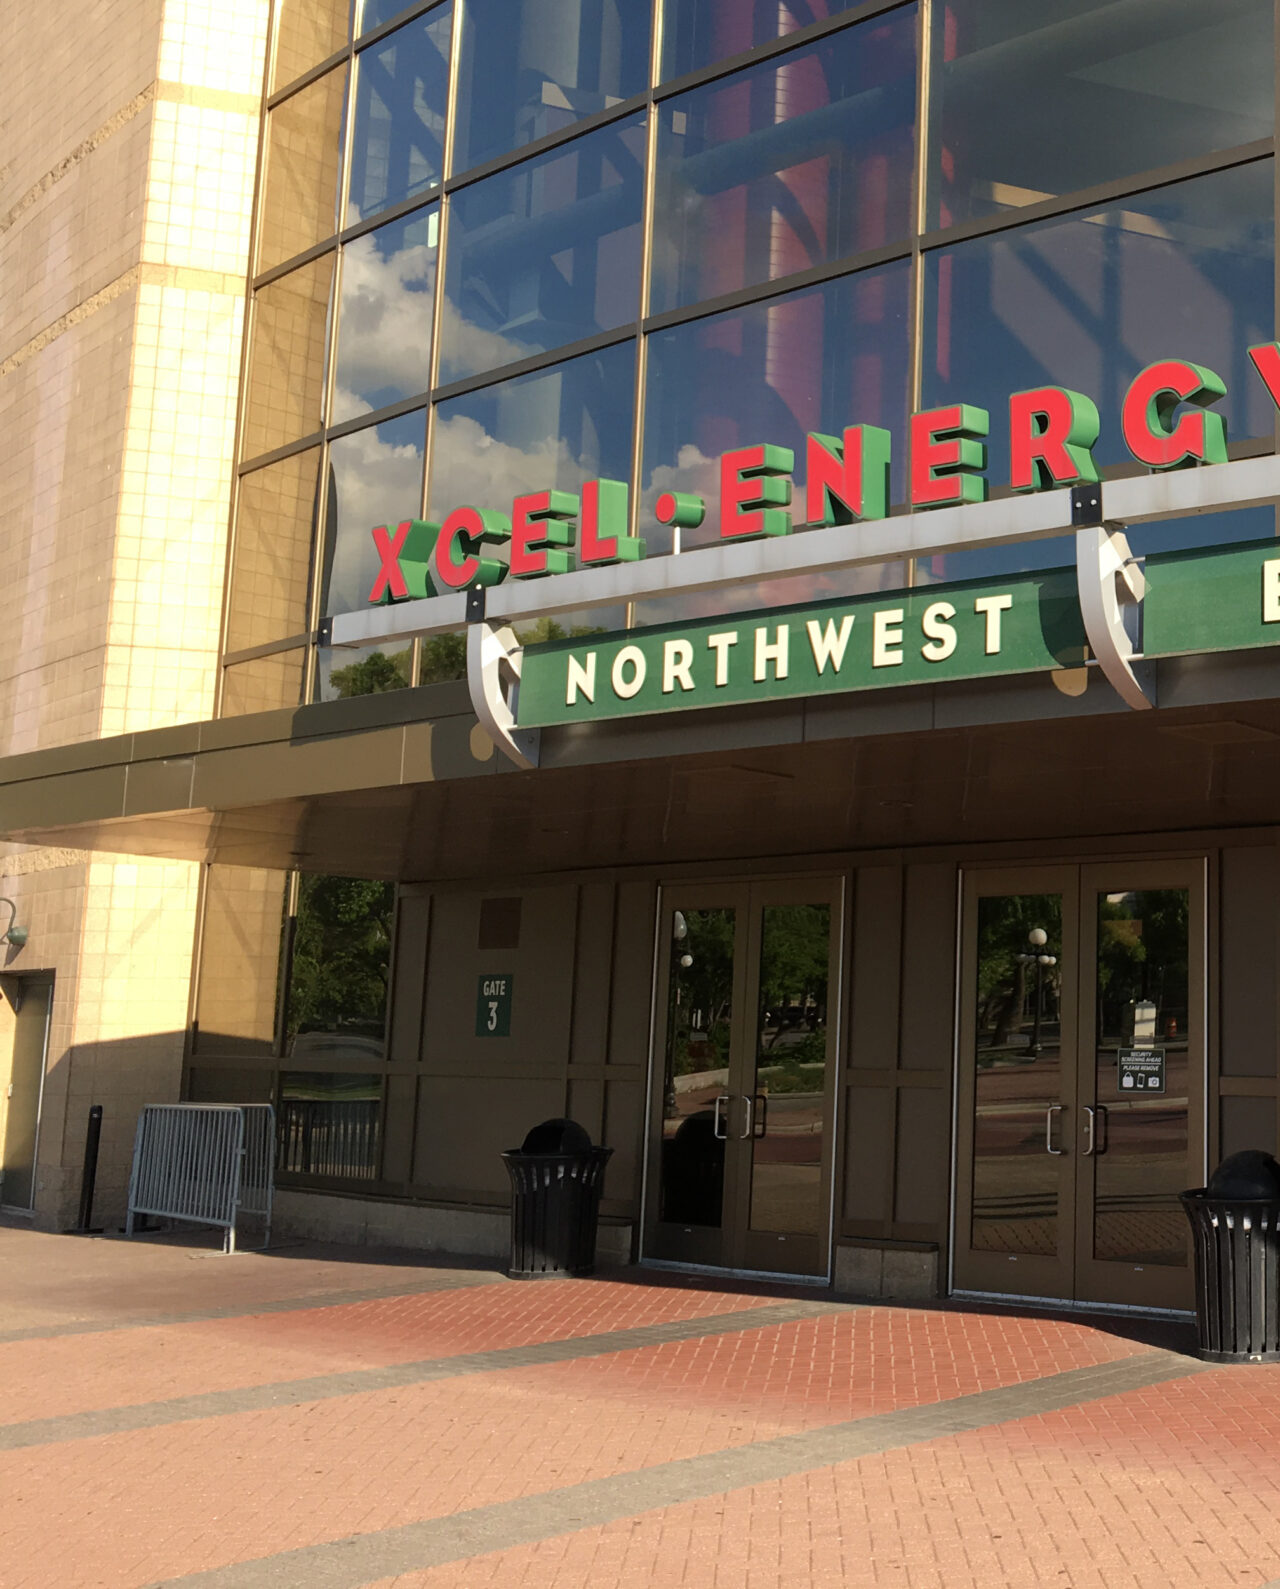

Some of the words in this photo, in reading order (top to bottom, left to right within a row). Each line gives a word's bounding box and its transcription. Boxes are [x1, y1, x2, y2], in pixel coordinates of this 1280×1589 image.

[368, 478, 647, 604] XCEL
[565, 594, 1013, 704] NORTHWEST
[483, 980, 506, 996] GATE
[487, 1001, 498, 1031] 3
